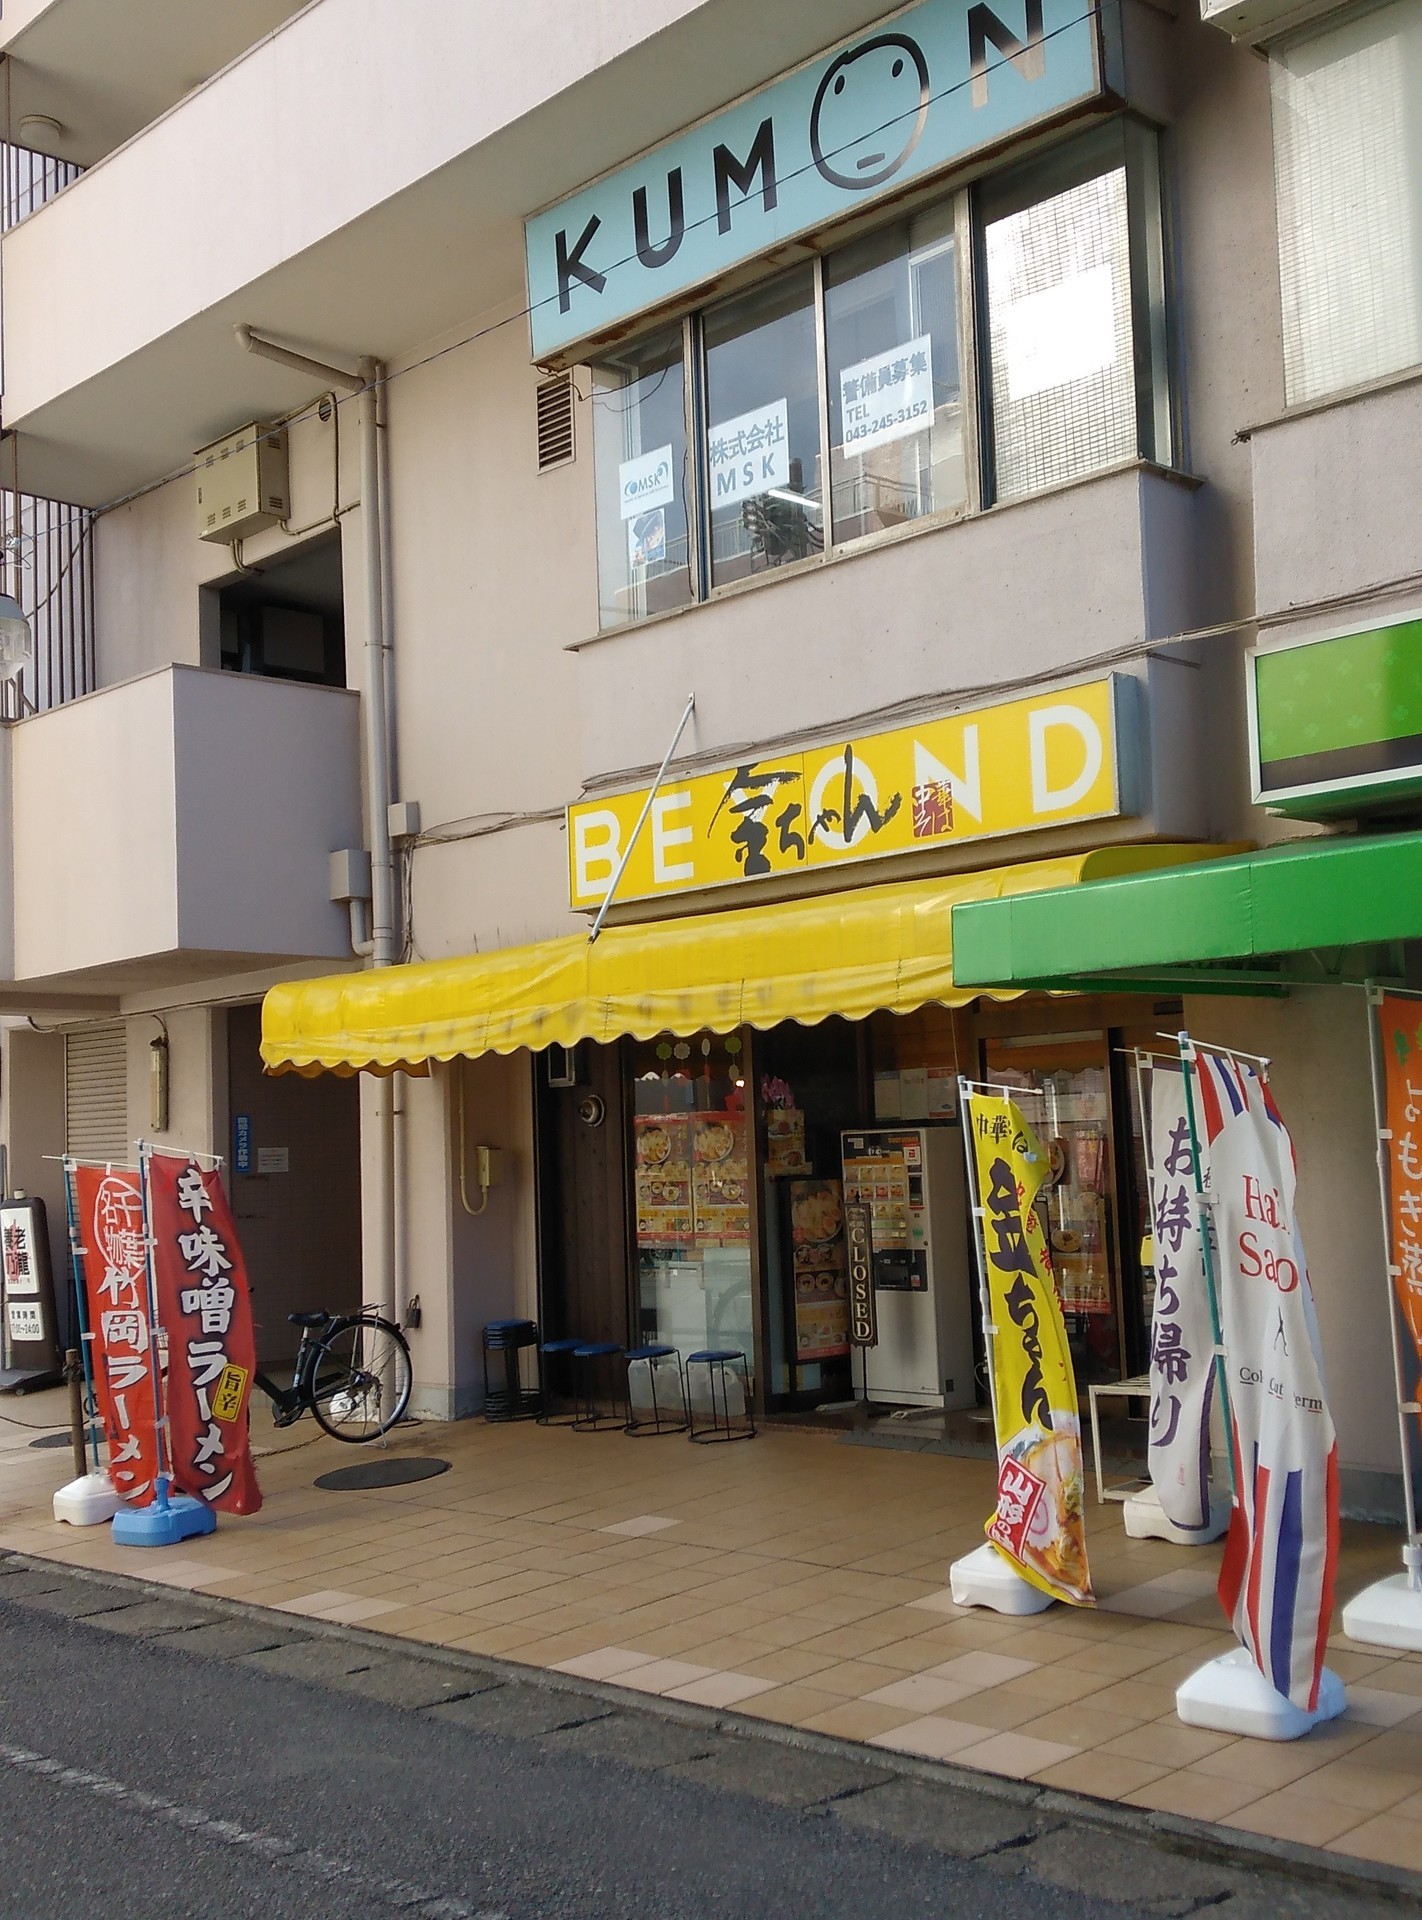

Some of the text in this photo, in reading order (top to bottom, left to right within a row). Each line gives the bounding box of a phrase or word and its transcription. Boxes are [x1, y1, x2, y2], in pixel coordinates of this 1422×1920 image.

[555, 0, 1047, 315] KUMON
[842, 350, 928, 405] 警備員募集
[845, 400, 928, 443] 043-245-3152
[846, 402, 870, 424] TEL
[709, 415, 785, 467] 株式会社
[851, 1227, 870, 1338] CLOSED
[1151, 1116, 1203, 1447] お持ち帰り
[177, 1167, 236, 1502] 辛味噌ラーメン
[97, 1266, 149, 1501] 竹岡ラーメン
[221, 1370, 242, 1412] 旨辛
[1293, 1391, 1323, 1410] erm
